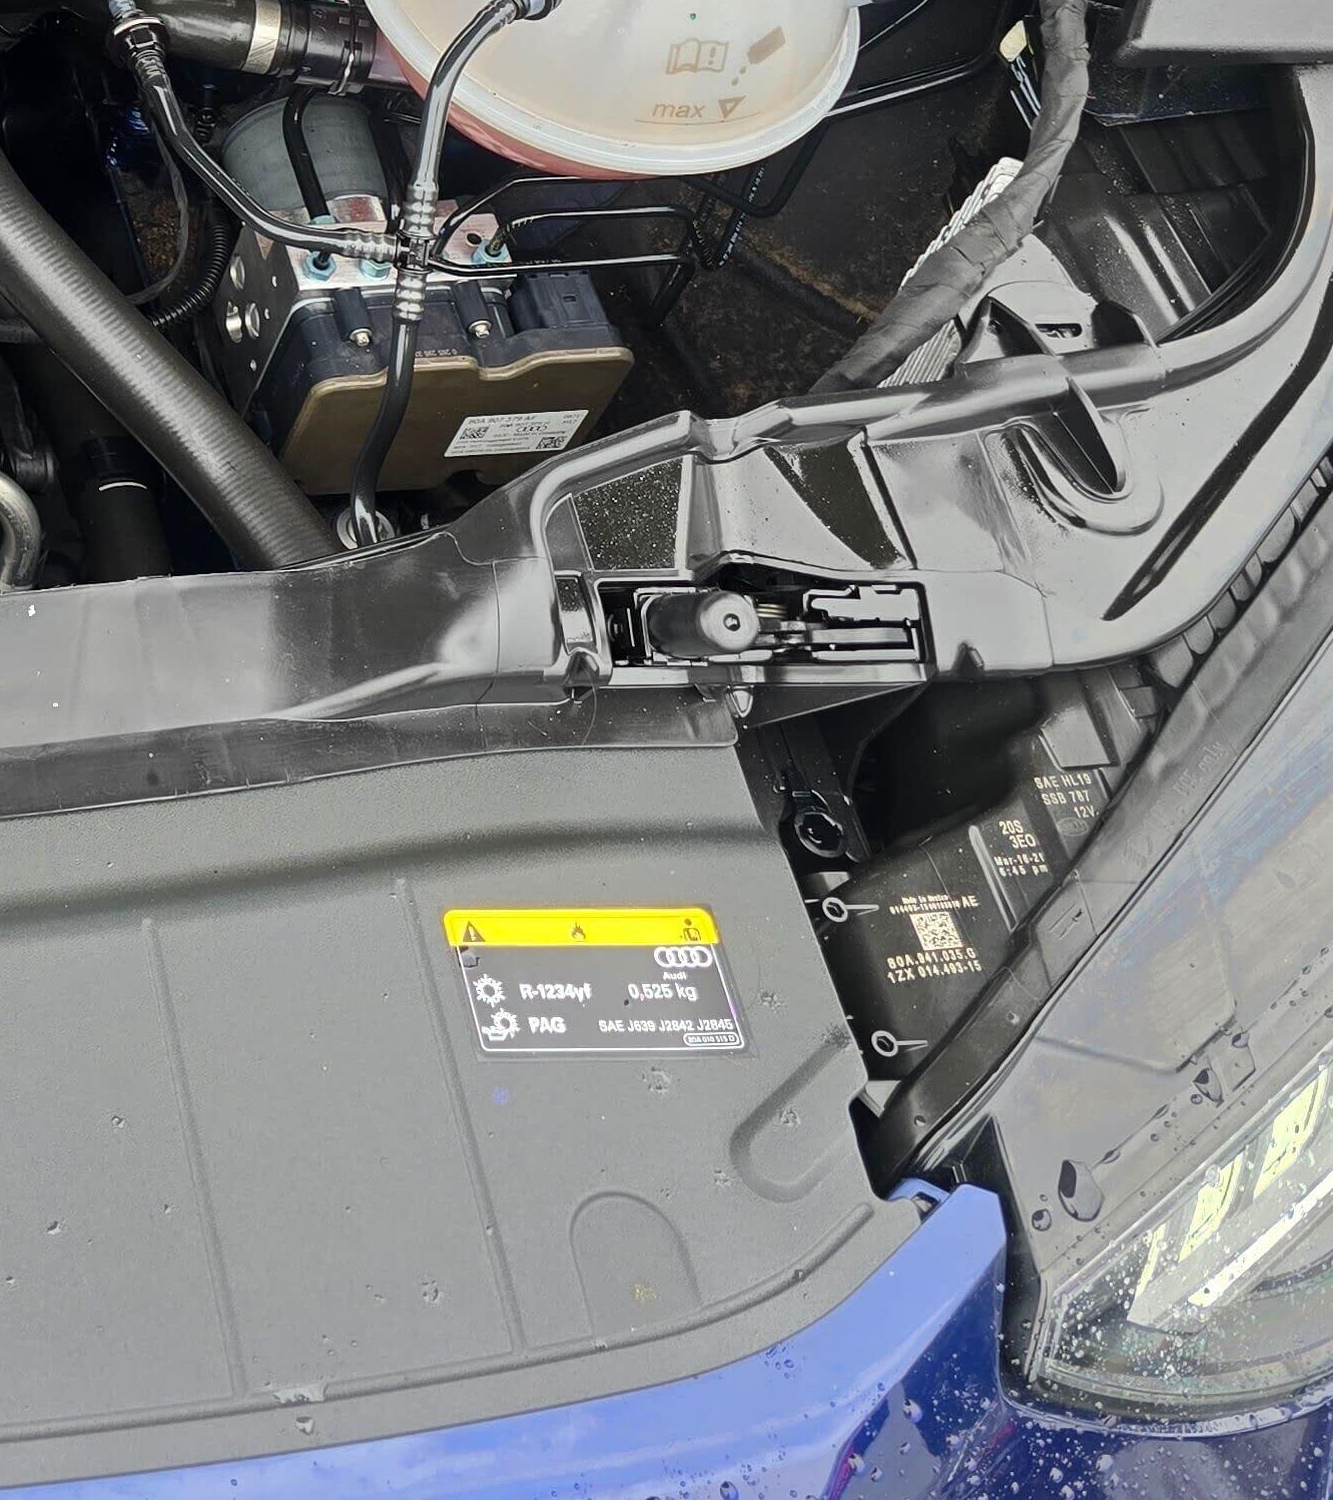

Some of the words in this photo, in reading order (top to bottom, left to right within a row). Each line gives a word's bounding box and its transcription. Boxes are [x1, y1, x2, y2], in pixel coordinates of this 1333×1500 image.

[652, 103, 706, 118] max
[1033, 775, 1060, 790] SAE
[1060, 772, 1092, 788] HL19
[1041, 791, 1067, 806] SSB
[1068, 789, 1090, 803] 787
[998, 819, 1024, 836] 20S
[1031, 864, 1049, 876] pm
[961, 895, 980, 909] AE
[662, 970, 687, 981] Audi
[887, 967, 916, 984] 1ZX
[519, 982, 593, 1003] R-1234yf
[627, 983, 673, 1002] 0,525
[676, 982, 699, 1002] kg
[528, 1016, 567, 1034] PAG
[598, 1019, 625, 1033] SAE
[627, 1019, 656, 1033] J639
[658, 1019, 695, 1033] J2842
[696, 1018, 734, 1032] J2845
